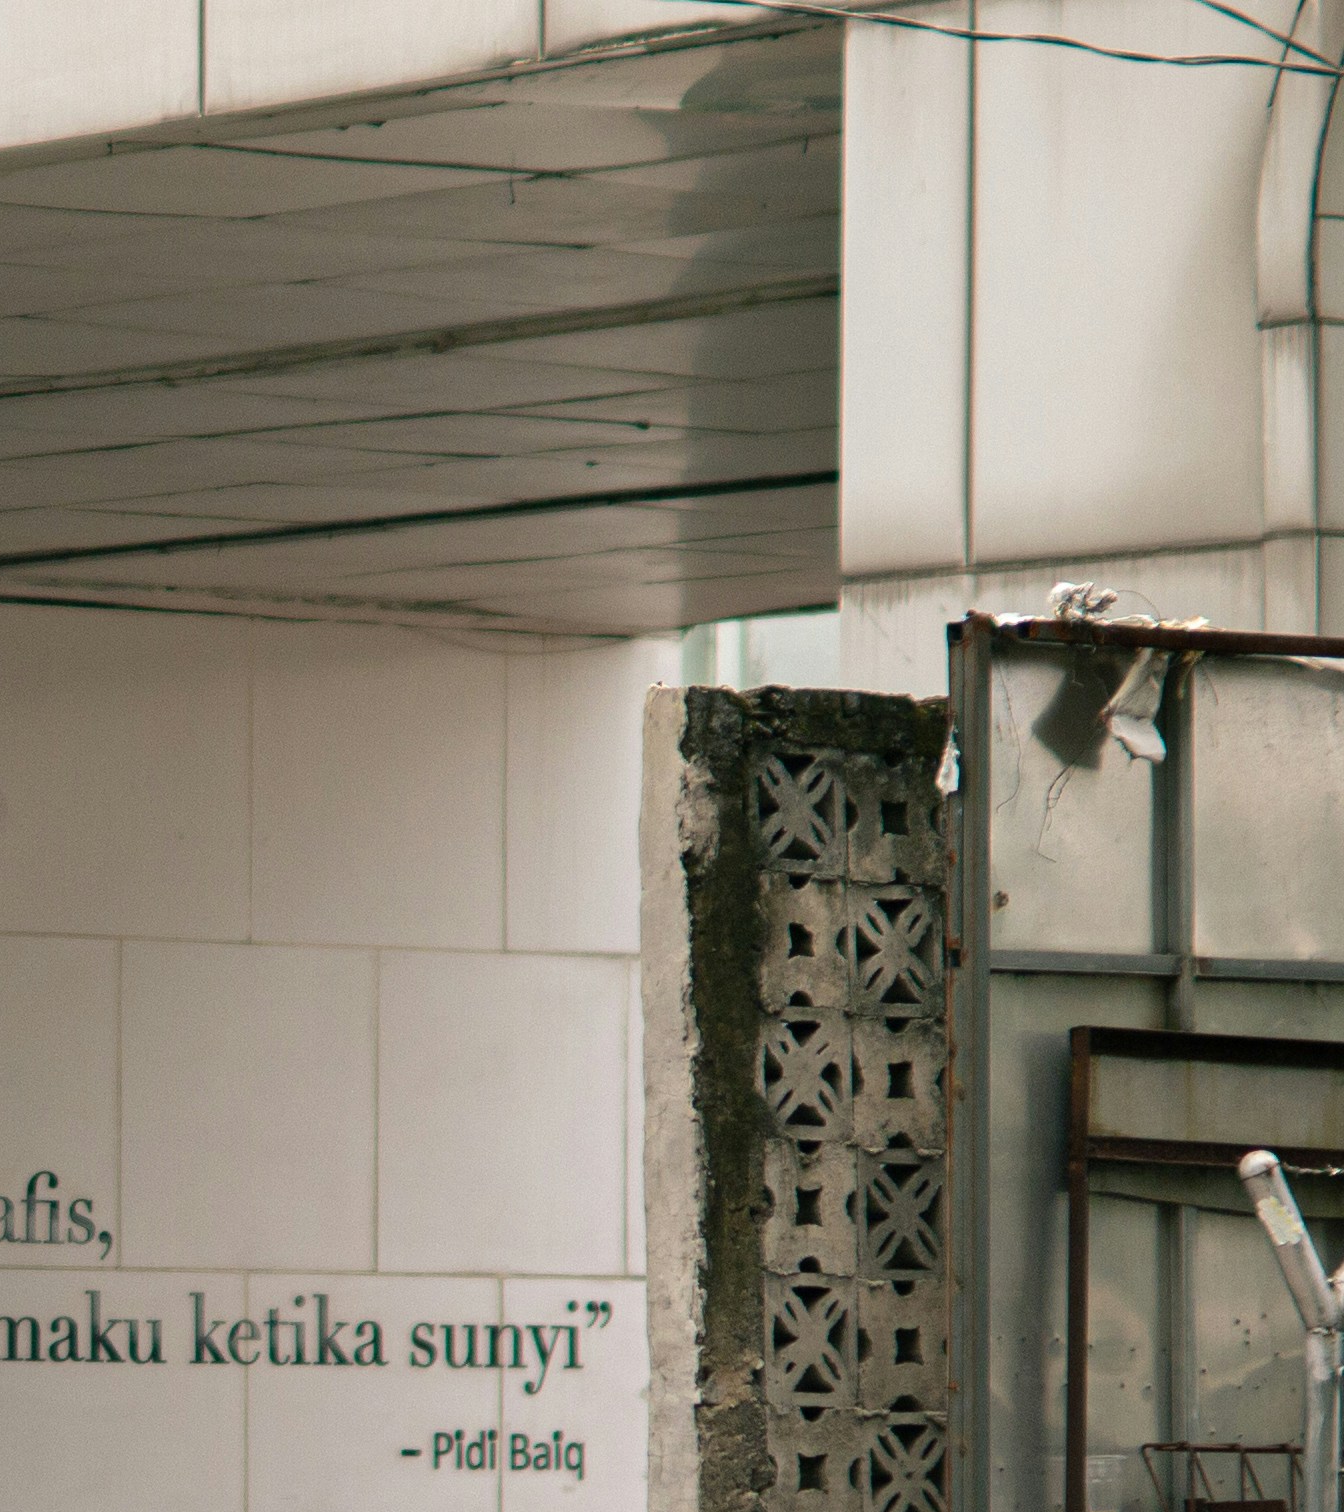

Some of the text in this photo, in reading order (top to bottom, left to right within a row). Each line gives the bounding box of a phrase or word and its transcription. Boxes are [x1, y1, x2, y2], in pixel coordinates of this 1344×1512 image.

[188, 1291, 389, 1367] ketika
[408, 1300, 613, 1396] sunyi”
[432, 1429, 498, 1471] Pidi
[509, 1430, 585, 1480] Baiq
